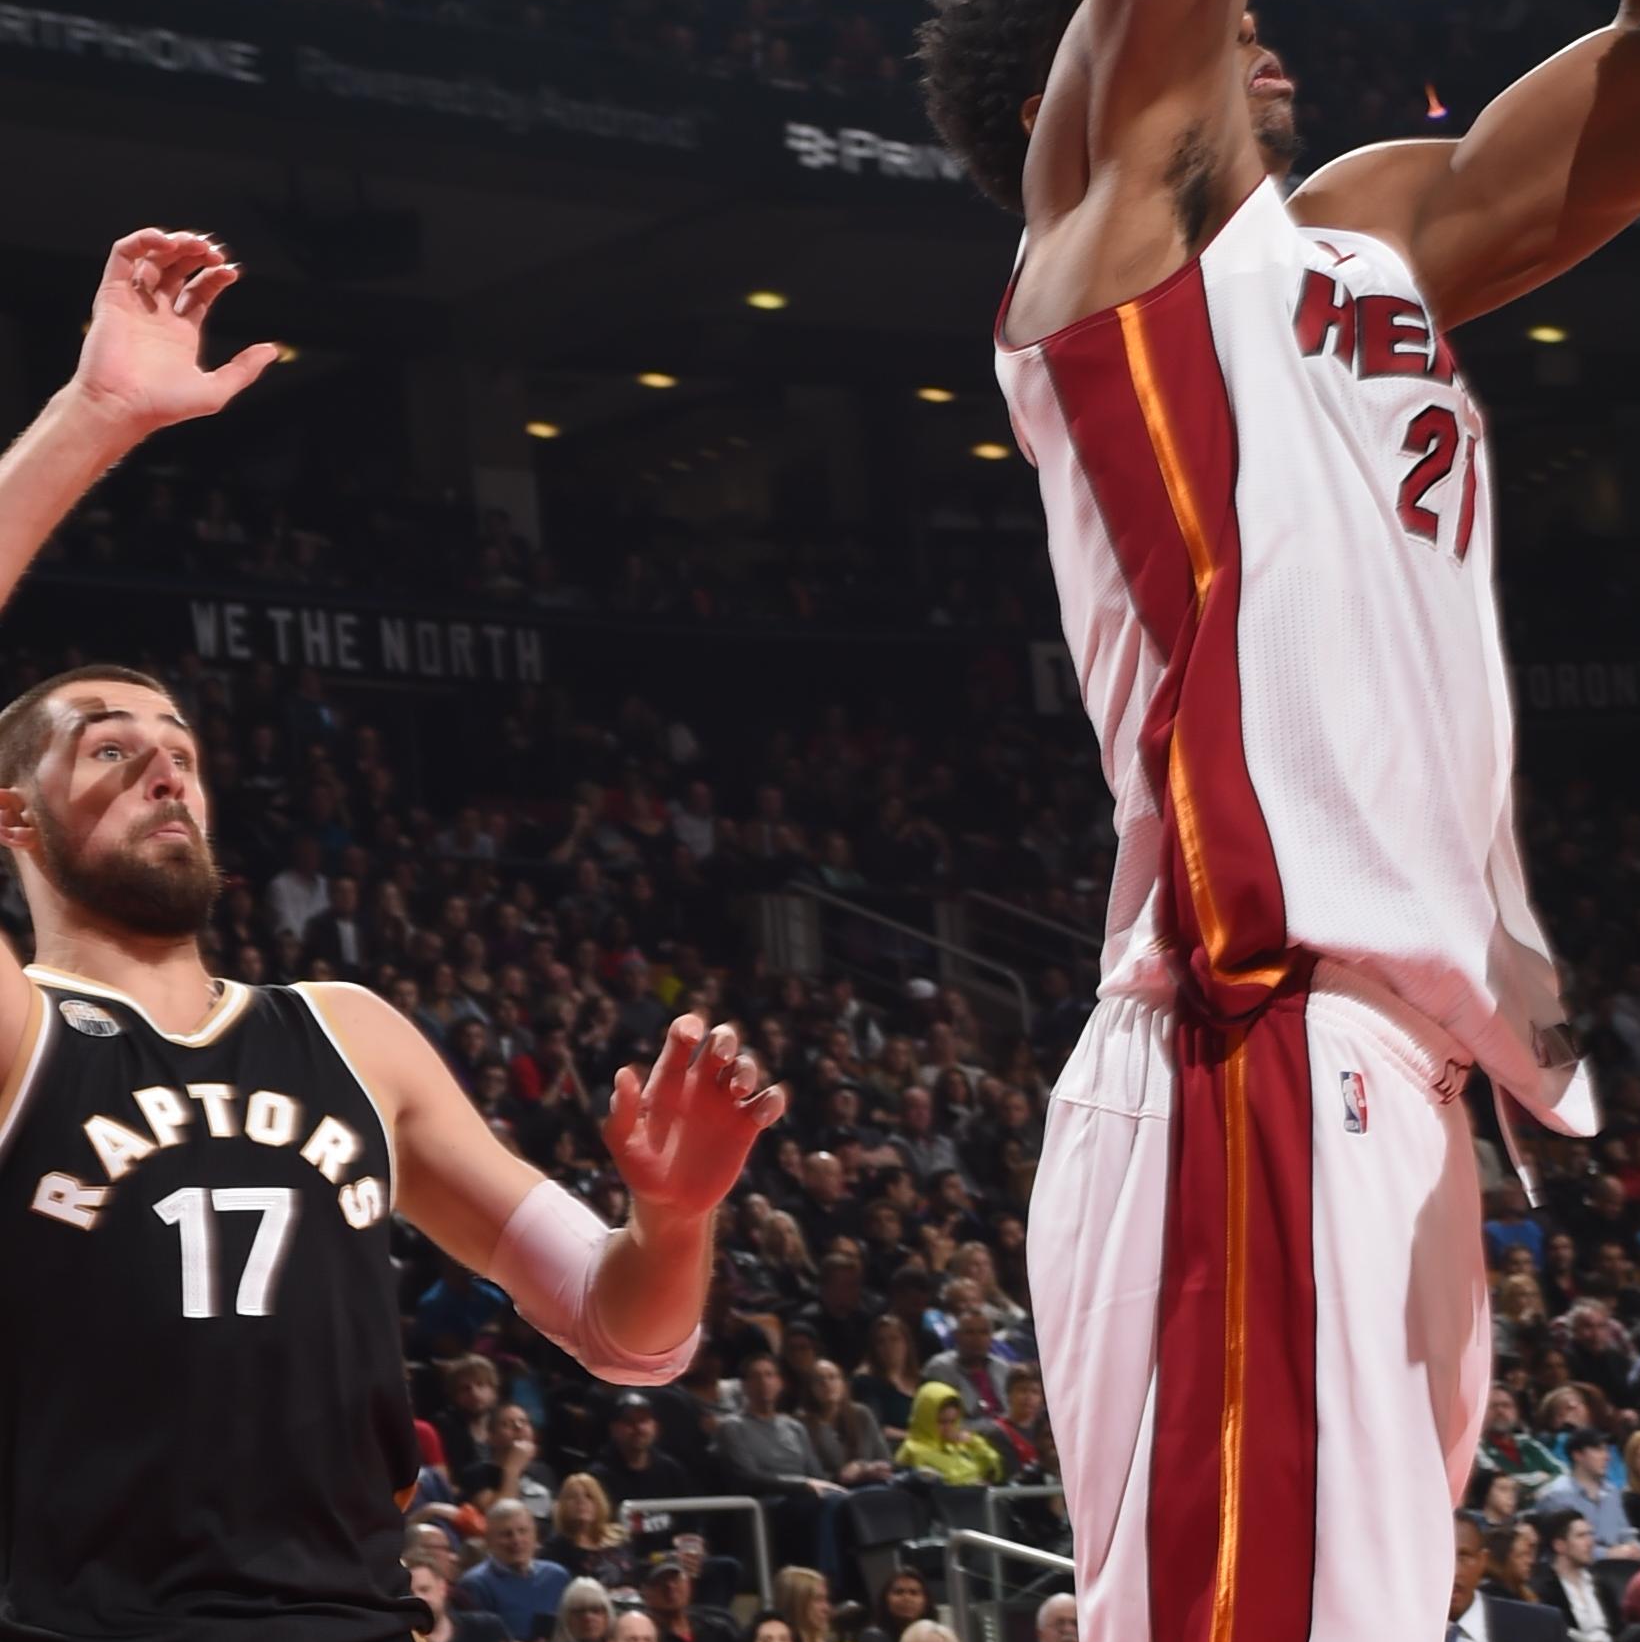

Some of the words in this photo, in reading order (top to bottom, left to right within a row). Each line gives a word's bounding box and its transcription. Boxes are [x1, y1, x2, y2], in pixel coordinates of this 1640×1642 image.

[190, 600, 252, 658] WE
[267, 607, 363, 672] THE
[378, 616, 545, 684] NORTH
[30, 1083, 384, 1232] RAPTORS
[152, 1187, 300, 1319] 17
